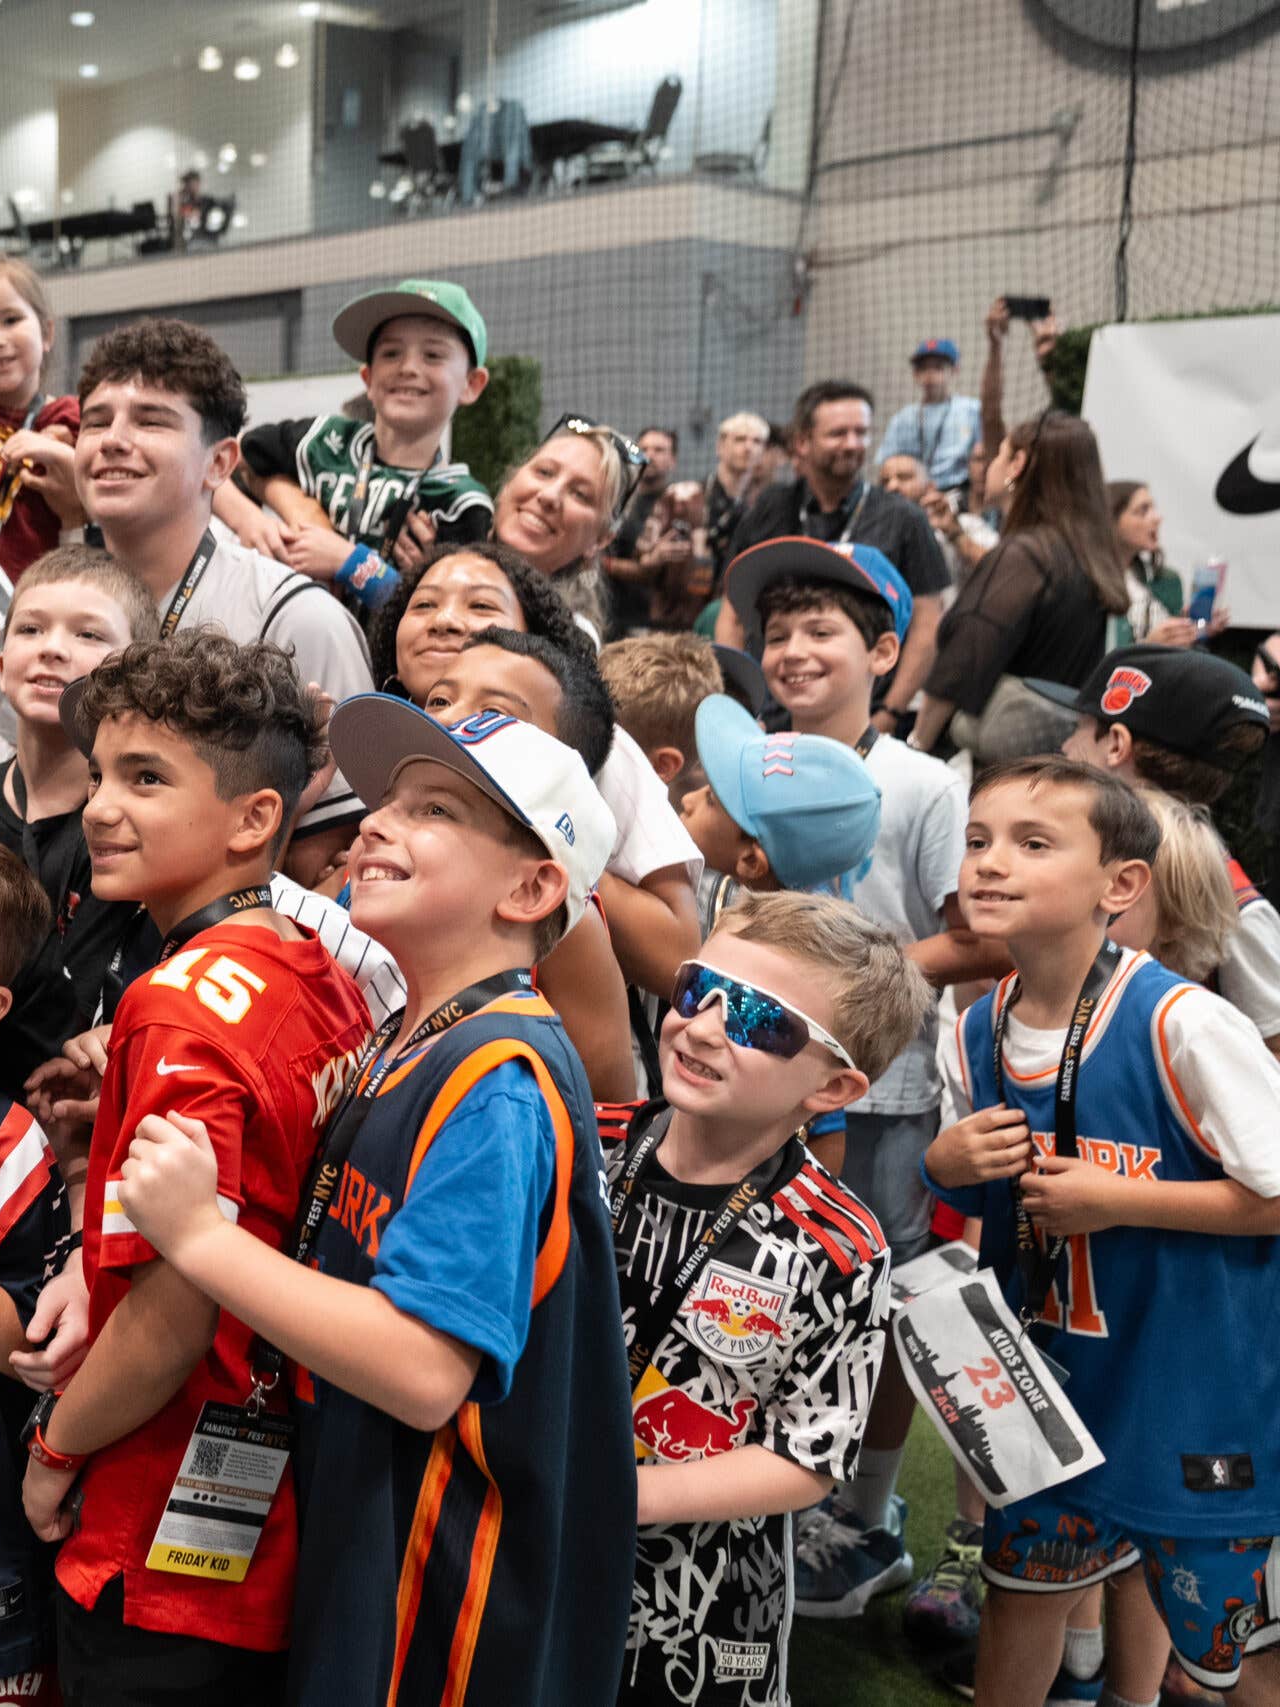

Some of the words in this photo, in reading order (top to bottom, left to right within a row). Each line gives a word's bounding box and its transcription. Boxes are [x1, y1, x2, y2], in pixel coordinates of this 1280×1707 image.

[230, 890, 260, 908] NYC
[148, 947, 268, 1024] 15
[432, 1001, 464, 1030] NYC
[1074, 998, 1094, 1025] NYC
[1070, 1024, 1082, 1046] FEST
[1061, 1059, 1074, 1101] FANATICS
[626, 1135, 655, 1178] FANATICS
[313, 1163, 338, 1201] NYC
[306, 1198, 324, 1227] FEST
[610, 1192, 626, 1218] FEST
[674, 1243, 708, 1289] FANATICS
[713, 1207, 734, 1234] FEST
[734, 1182, 759, 1213] NYC
[710, 1275, 746, 1299] Red
[748, 1285, 782, 1311] Bull
[703, 1322, 727, 1347] NEW
[730, 1336, 763, 1353] YORK
[962, 1357, 1016, 1410] 23
[989, 1328, 1020, 1366] KIDS
[1013, 1367, 1049, 1413] ZONE
[930, 1385, 961, 1424] ZACH
[202, 1422, 237, 1437] FANATICS
[247, 1432, 266, 1442] FEST
[167, 1550, 209, 1570] FRIDAY
[209, 1557, 230, 1572] KID
[722, 1655, 733, 1665] 50
[735, 1656, 763, 1667] YEARS
